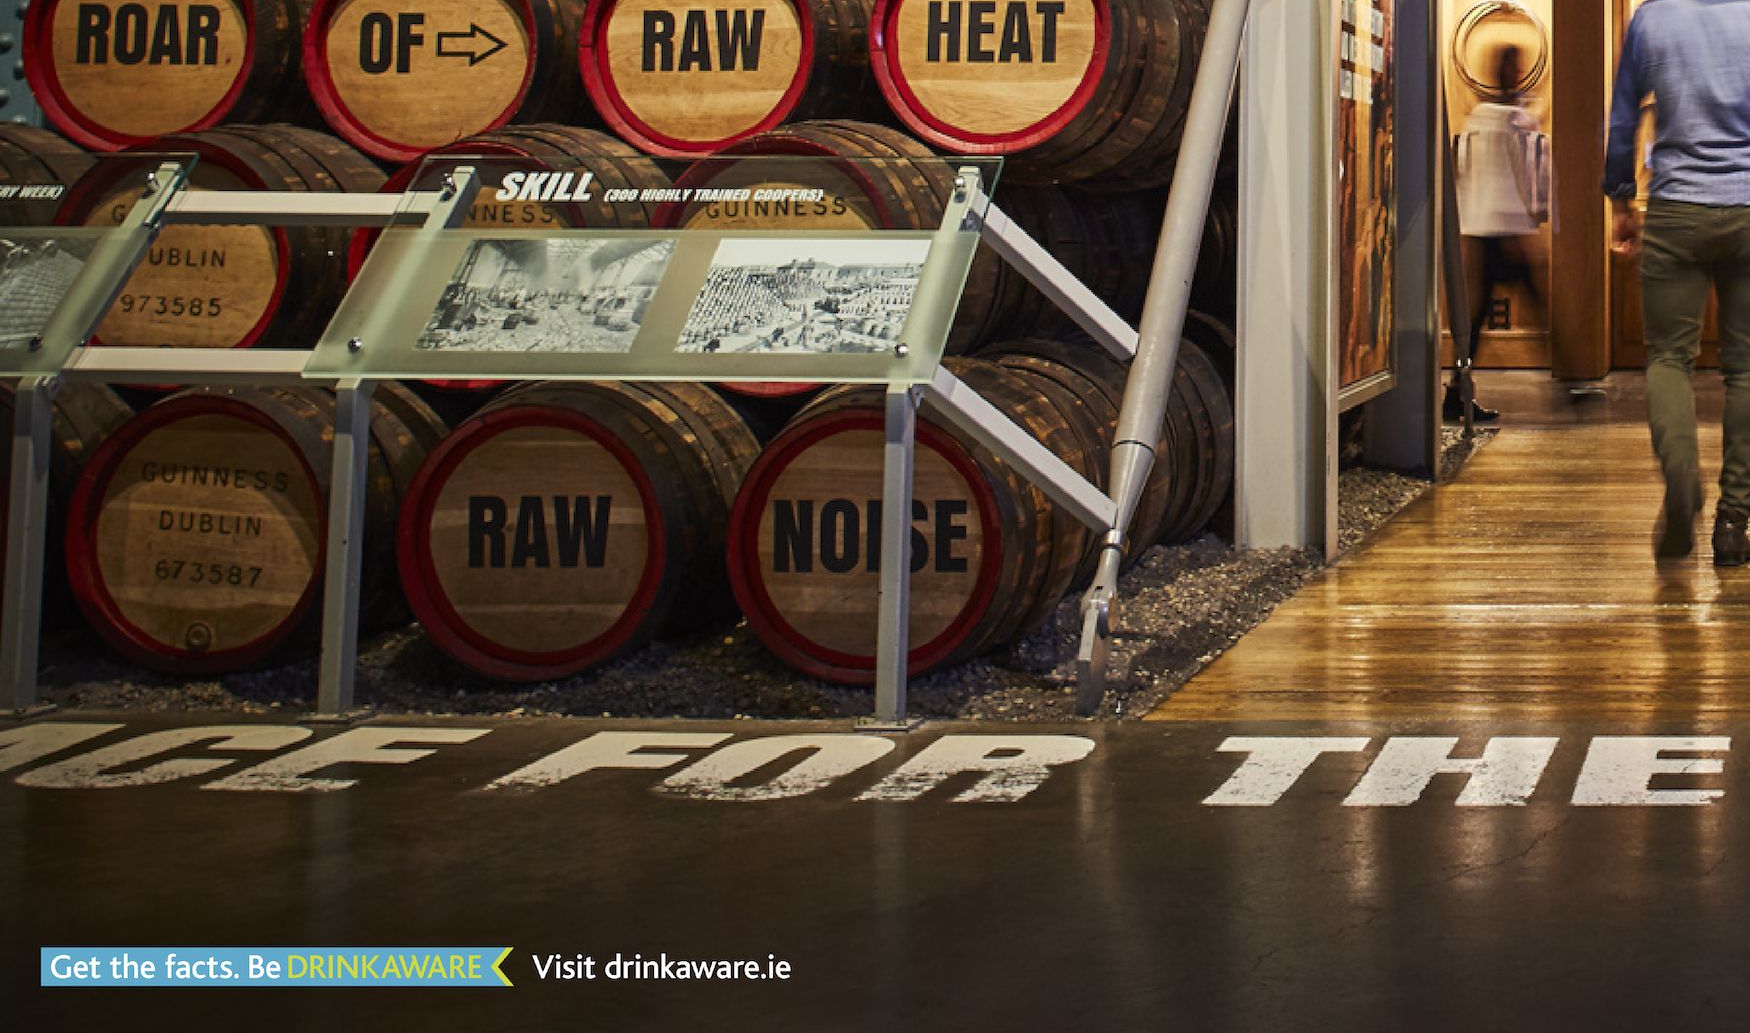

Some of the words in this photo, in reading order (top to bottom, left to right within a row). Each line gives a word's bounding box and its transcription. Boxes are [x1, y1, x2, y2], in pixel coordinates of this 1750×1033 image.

[75, 3, 222, 66] ROAR
[358, 11, 425, 73] OF
[641, 8, 766, 72] RAW
[926, 0, 1065, 63] HEAT
[496, 171, 594, 203] SKILL
[640, 188, 693, 202] HIGHLY
[693, 188, 751, 202] TRAINED
[753, 188, 825, 203] COOPERS)
[149, 248, 226, 268] UBLIN
[120, 295, 222, 317] 973585
[142, 463, 289, 493] GUINNESS
[159, 510, 262, 536] DUBLIN
[468, 495, 612, 569] RAW
[155, 561, 263, 586] 673587
[478, 732, 1096, 803] FOR
[1201, 736, 1731, 806] THE
